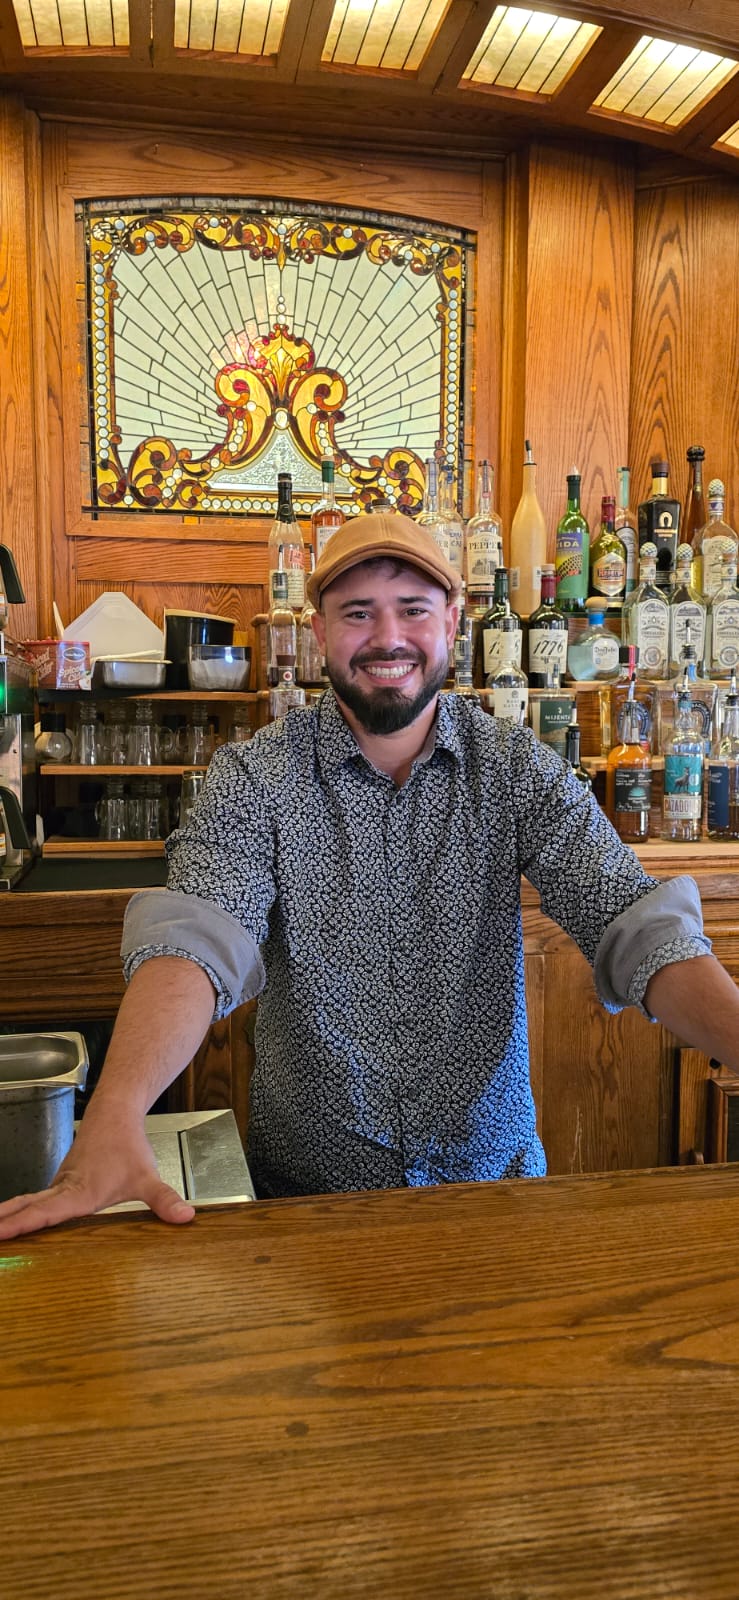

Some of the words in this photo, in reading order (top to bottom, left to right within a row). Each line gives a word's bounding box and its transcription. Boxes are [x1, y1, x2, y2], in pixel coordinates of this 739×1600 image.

[469, 541, 502, 549] PEPPE
[533, 639, 564, 656] 1776
[664, 799, 700, 813] CAZADO
